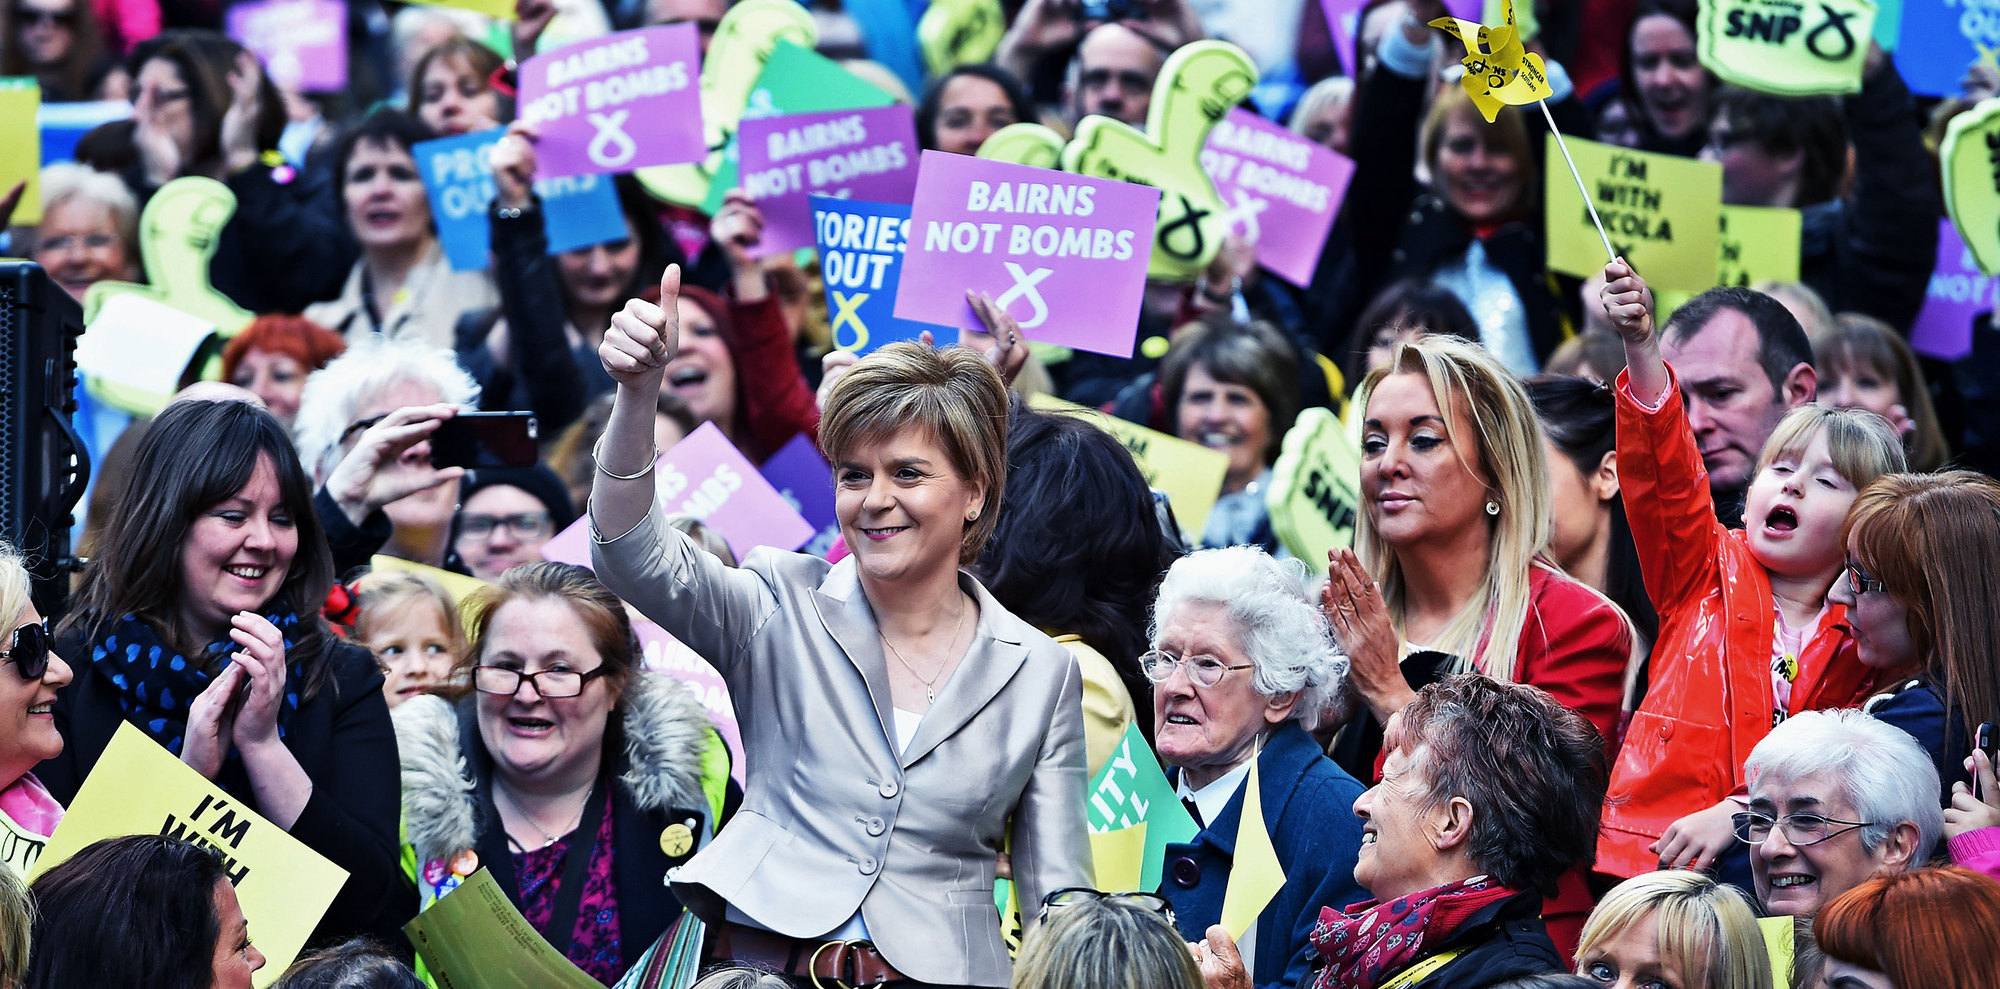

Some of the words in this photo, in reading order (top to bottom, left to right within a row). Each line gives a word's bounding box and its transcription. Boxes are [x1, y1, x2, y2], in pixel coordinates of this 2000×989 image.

[1724, 9, 1801, 44] SNP
[547, 36, 649, 87] BAIRNS
[1522, 57, 1544, 85] STRONGER
[521, 86, 581, 124] NOT
[584, 61, 690, 111] BOMBS
[767, 114, 867, 162] BAIRNS
[744, 163, 803, 199] NOT
[807, 141, 908, 187] BOMBS
[1609, 155, 1647, 181] I'M
[967, 180, 1097, 217] BAIRNS
[1597, 181, 1662, 211] WITH
[924, 220, 1003, 254] NOT
[1007, 224, 1136, 261] BOMBS
[1583, 206, 1673, 240] NCOLA
[824, 250, 894, 290] OUT
[189, 794, 252, 849] I'M
[159, 813, 250, 888] WH
